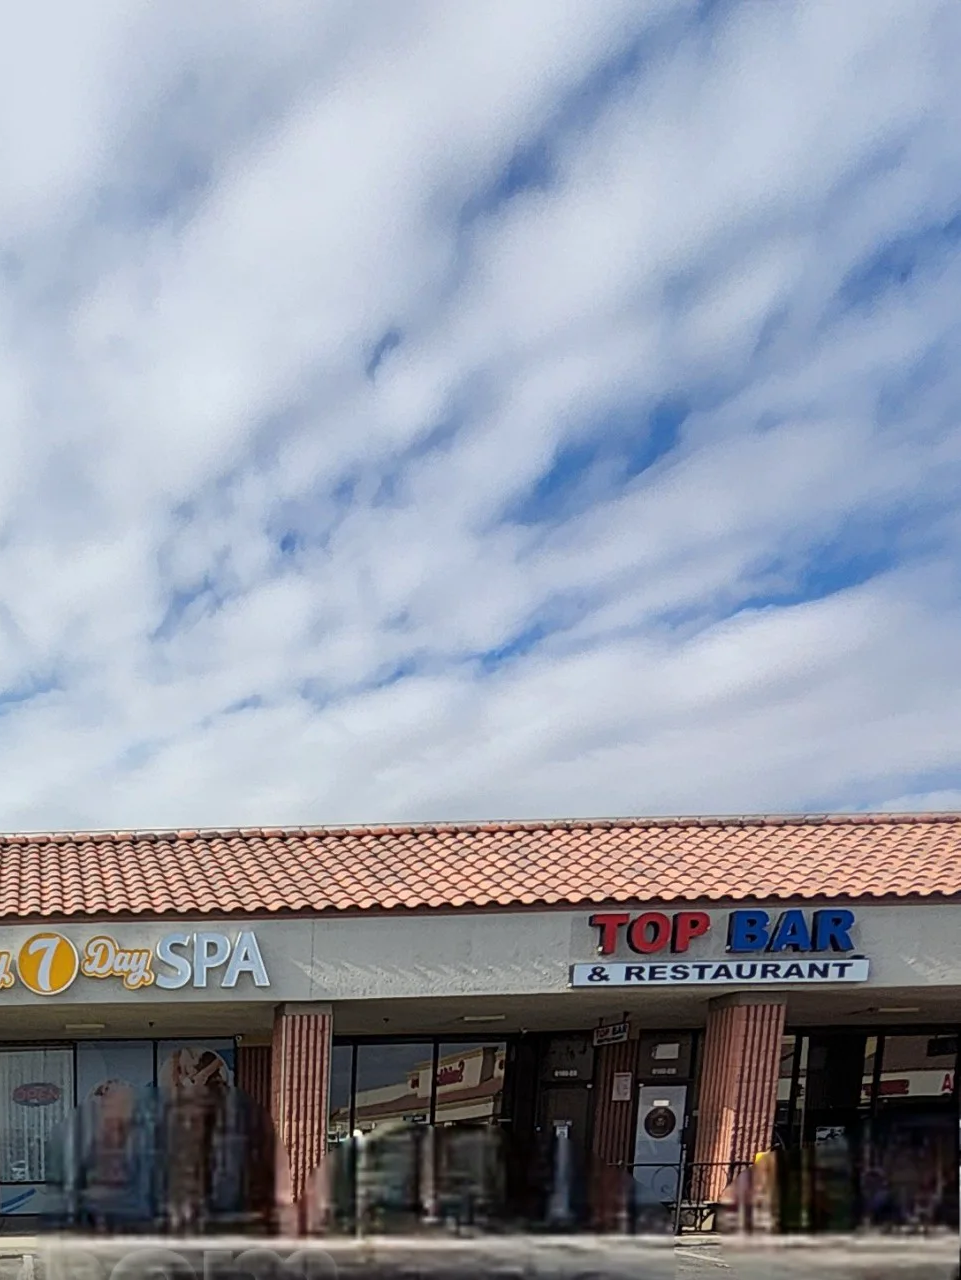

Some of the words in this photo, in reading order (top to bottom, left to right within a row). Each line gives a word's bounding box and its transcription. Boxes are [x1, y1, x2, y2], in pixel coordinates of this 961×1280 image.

[589, 911, 711, 954] TOP
[725, 909, 855, 953] BAR
[27, 936, 61, 991] 7
[83, 937, 154, 990] Day
[155, 931, 271, 989] SPA
[587, 967, 610, 982] &
[624, 962, 854, 981] RESTAURANT
